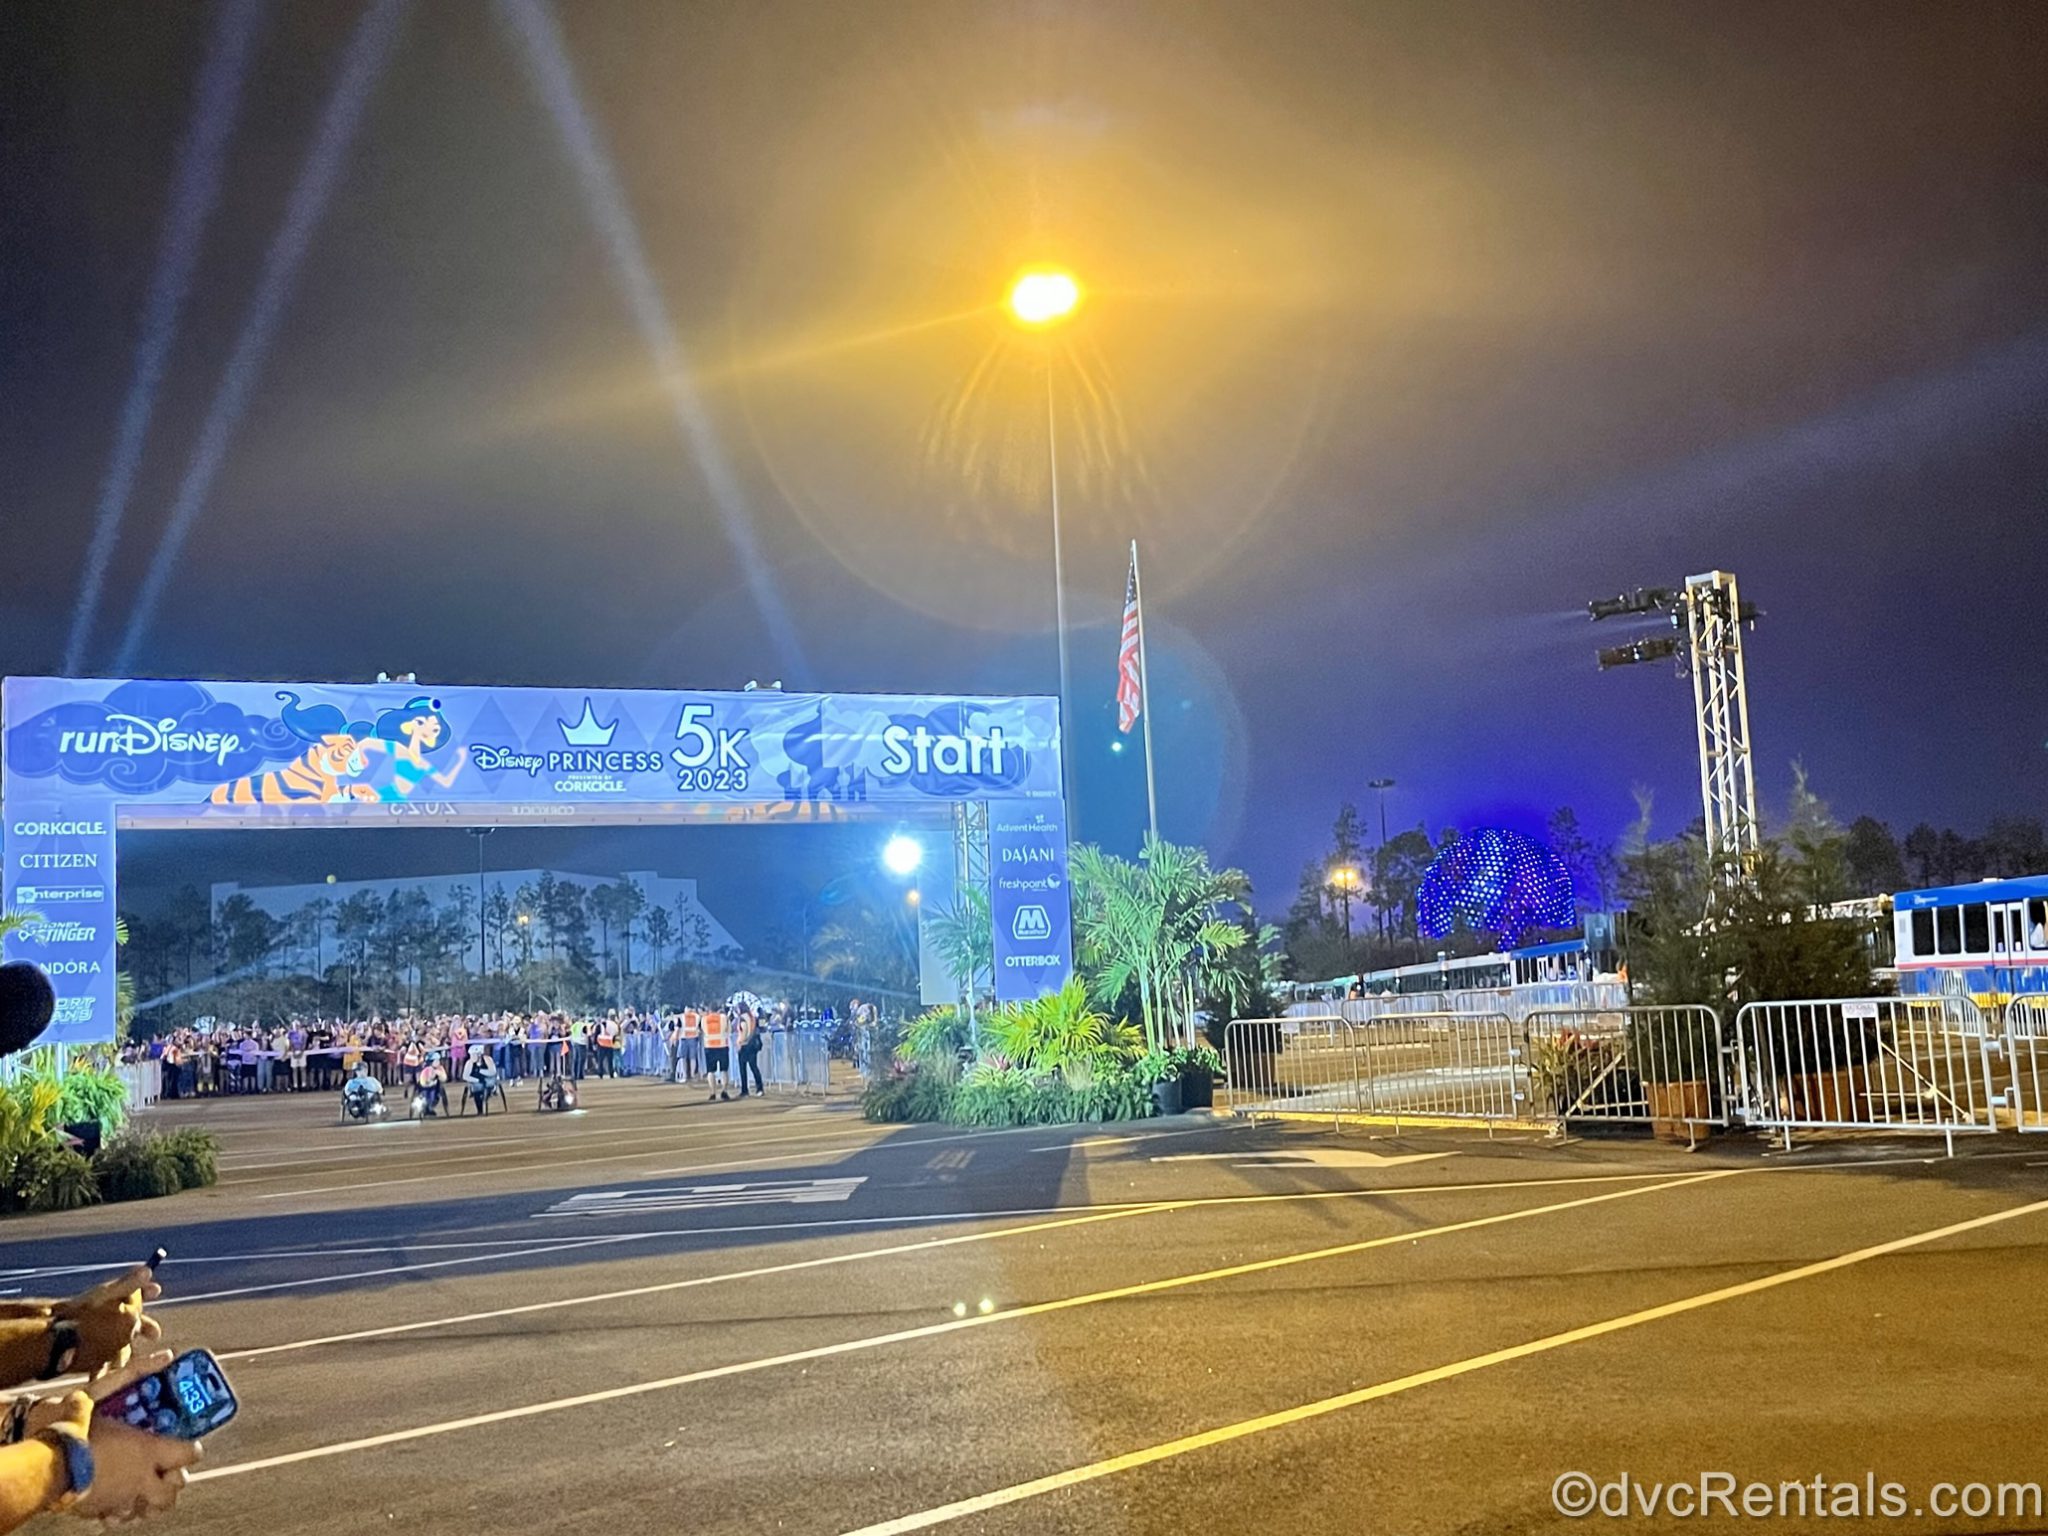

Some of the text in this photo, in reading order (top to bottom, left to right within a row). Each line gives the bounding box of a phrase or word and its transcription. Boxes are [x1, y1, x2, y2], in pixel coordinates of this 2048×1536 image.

[671, 704, 750, 768] 5K
[470, 743, 663, 777] Disney PRINCESS
[881, 725, 1006, 775] Start
[678, 767, 748, 791] 2023
[996, 822, 1058, 832] AdventHealth
[20, 854, 98, 868] CITIZEN
[1002, 845, 1054, 865] DASANI
[999, 876, 1047, 892] freshpoint
[1005, 955, 1060, 967] OTTERBOX
